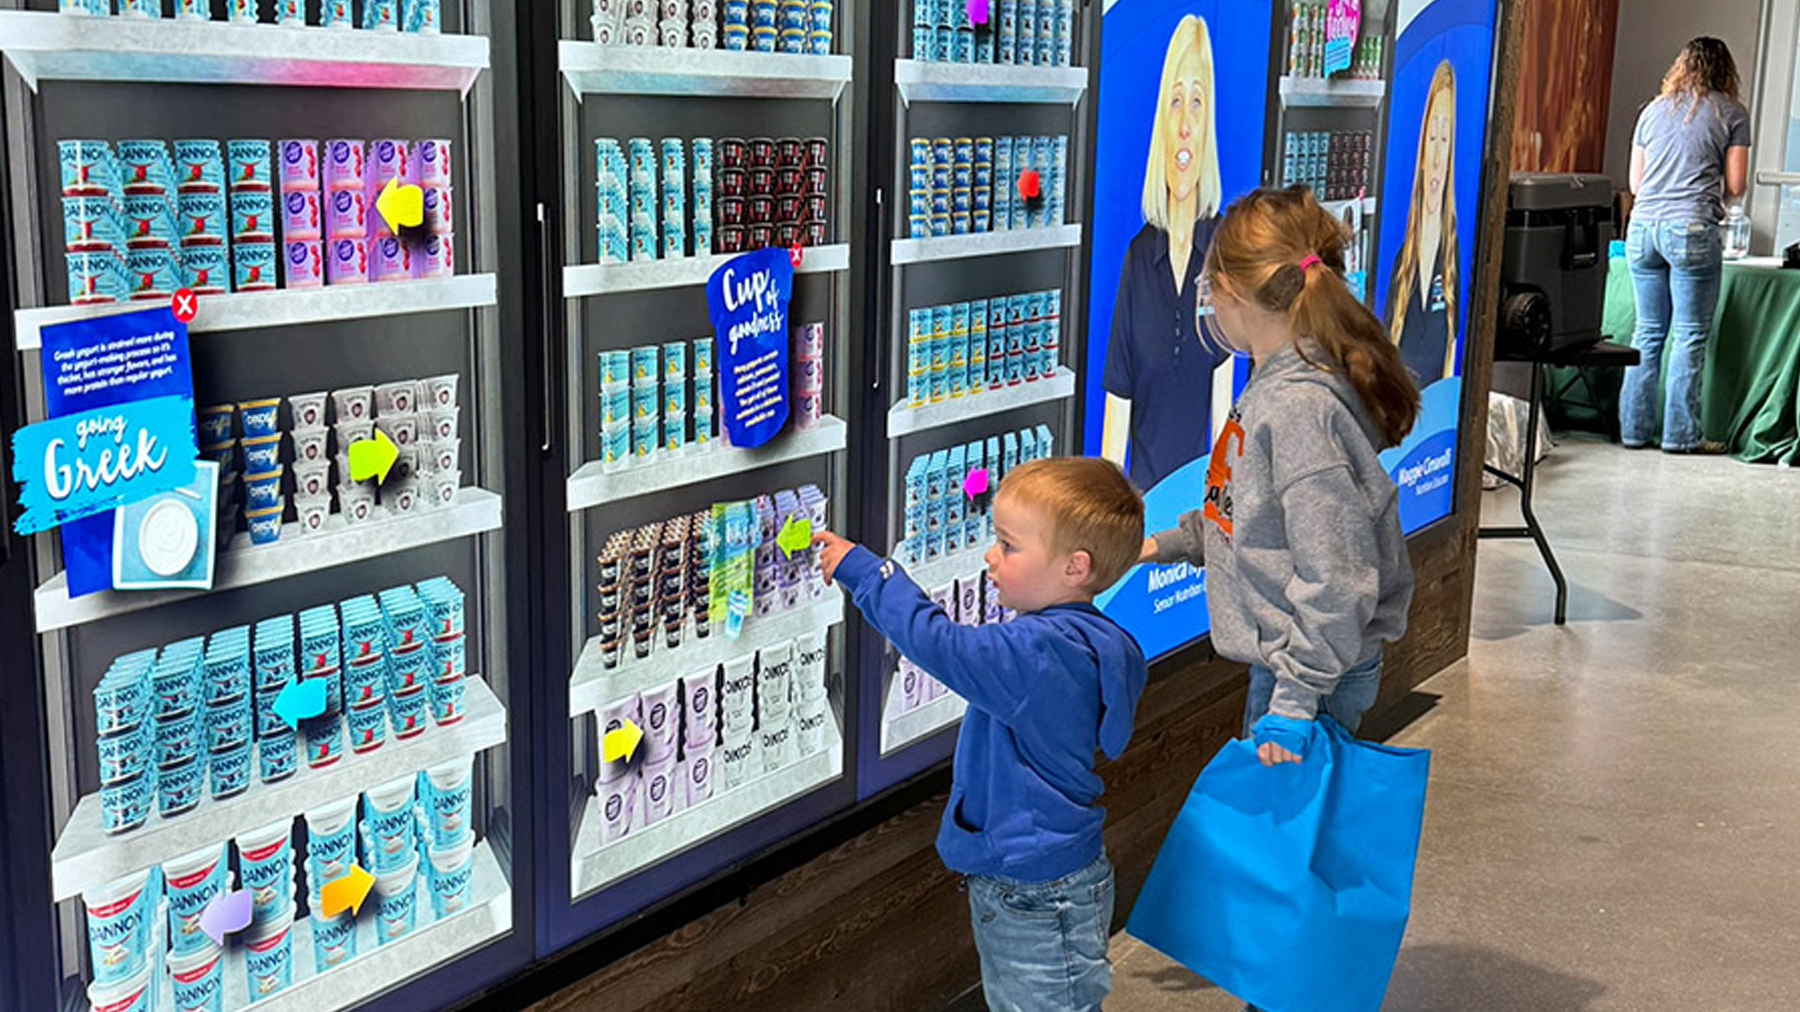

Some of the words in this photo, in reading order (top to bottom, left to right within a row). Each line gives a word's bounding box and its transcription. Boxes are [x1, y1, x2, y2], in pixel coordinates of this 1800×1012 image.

[722, 267, 770, 313] Cup
[766, 277, 780, 312] of
[728, 310, 785, 356] goodness
[76, 414, 128, 448] going
[44, 427, 168, 499] Greek
[1148, 561, 1187, 594] Monica
